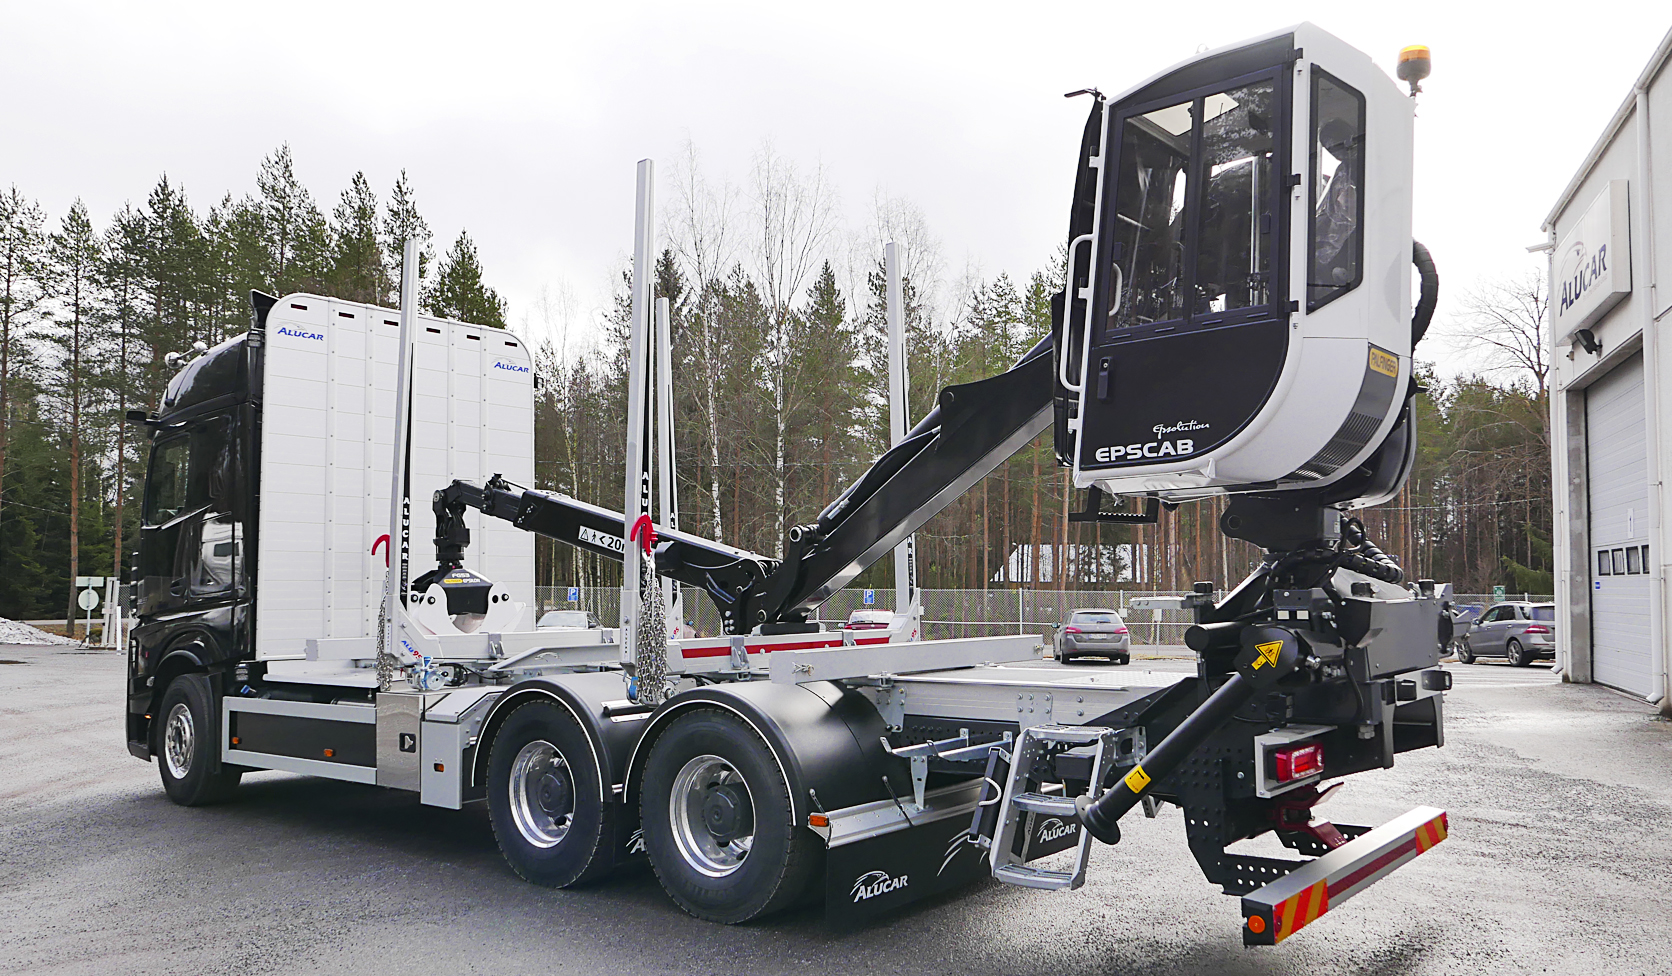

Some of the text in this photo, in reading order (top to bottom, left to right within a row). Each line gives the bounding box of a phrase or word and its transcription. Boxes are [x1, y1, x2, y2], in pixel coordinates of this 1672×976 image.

[1560, 243, 1607, 317] ALUCAR
[277, 326, 324, 341] ALUCAR
[494, 361, 530, 373] ALUCAR
[1095, 439, 1194, 462] EPSCAB
[401, 496, 410, 560] ALUCAR
[1039, 823, 1076, 844] ALUCAR
[853, 874, 909, 903] ALUCAR
